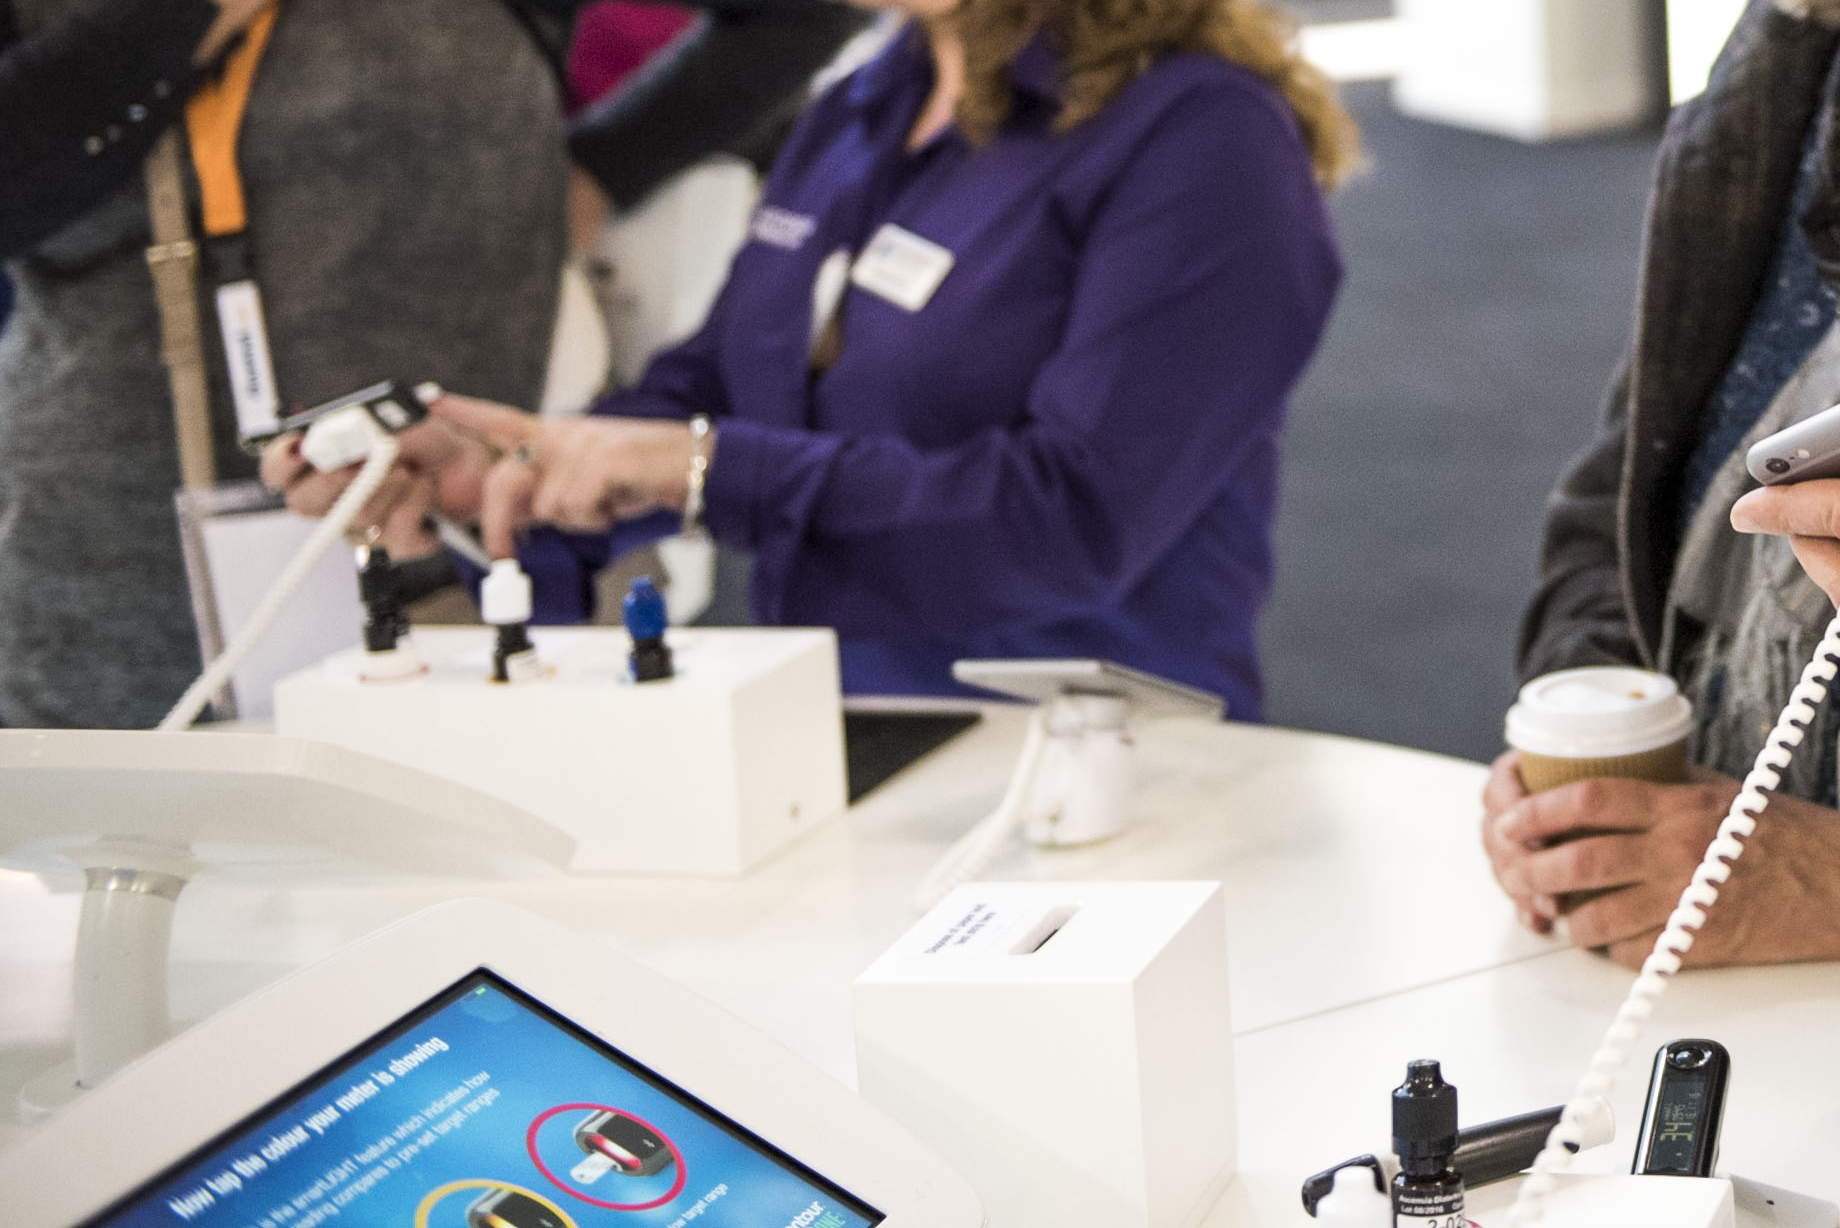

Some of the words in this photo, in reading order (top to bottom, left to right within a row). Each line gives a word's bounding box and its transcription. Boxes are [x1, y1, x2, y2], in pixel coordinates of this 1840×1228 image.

[205, 1169, 243, 1197] tap
[231, 1153, 268, 1179] the
[261, 1123, 310, 1162] colour
[304, 1104, 341, 1136] your
[335, 1079, 381, 1112] meter
[370, 1068, 395, 1086] is
[388, 1036, 450, 1077] showing
[353, 1136, 397, 1165] feature
[391, 1115, 427, 1141] which
[420, 1085, 471, 1119] indicates
[463, 1070, 491, 1089] how
[381, 1156, 402, 1170] to
[431, 1109, 468, 1134] target
[463, 1087, 500, 1114] ranges
[681, 1199, 709, 1221] target
[703, 1183, 729, 1202] range
